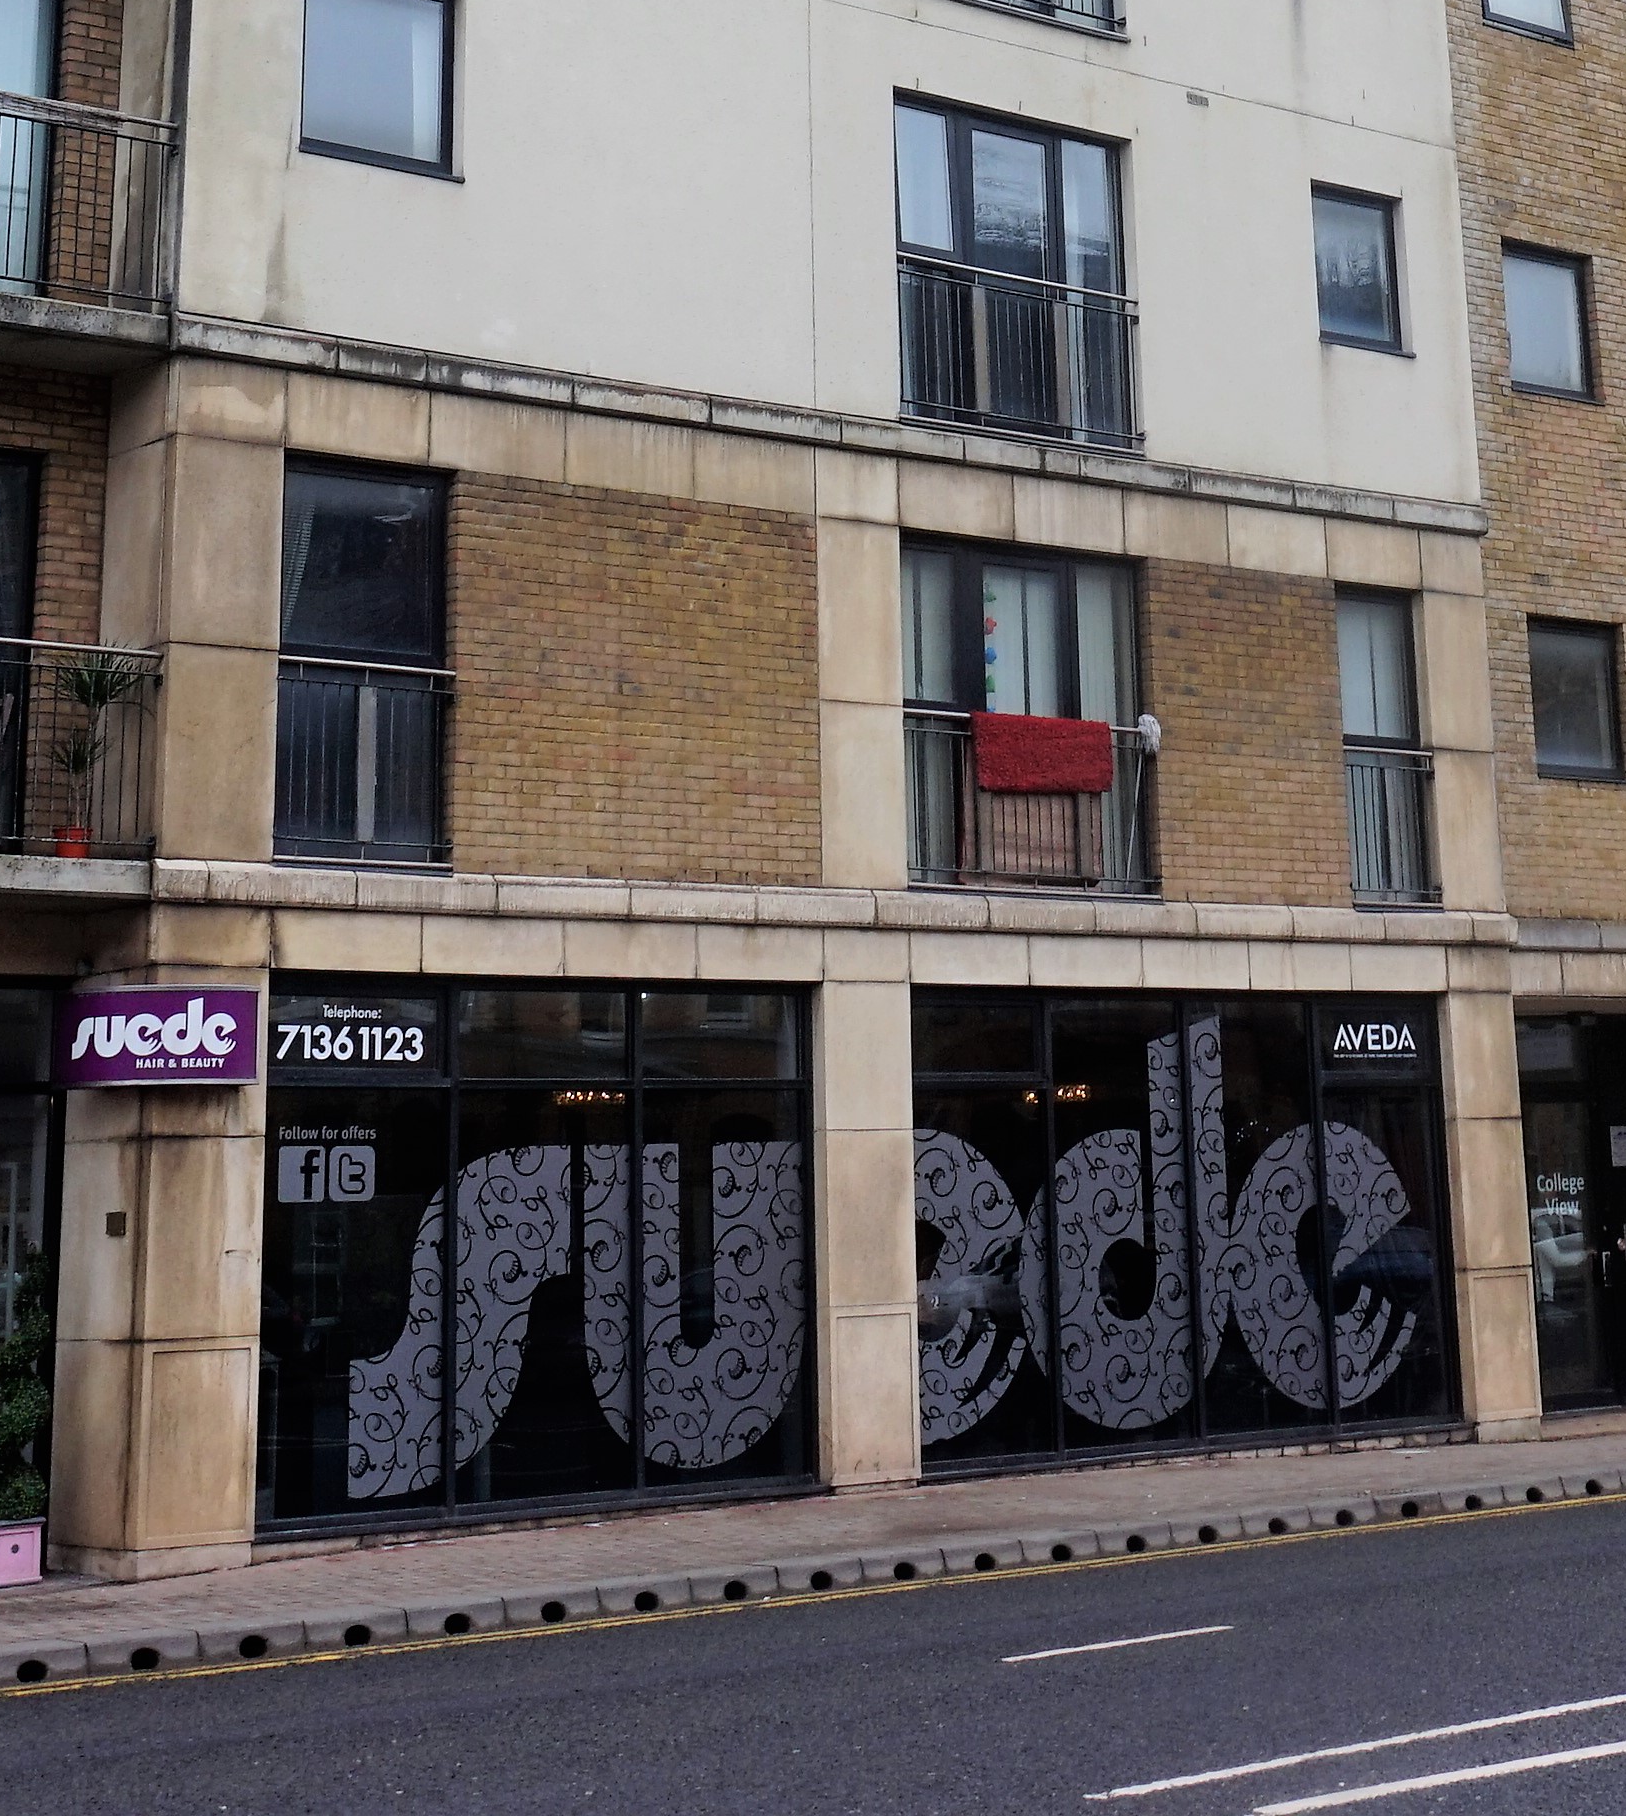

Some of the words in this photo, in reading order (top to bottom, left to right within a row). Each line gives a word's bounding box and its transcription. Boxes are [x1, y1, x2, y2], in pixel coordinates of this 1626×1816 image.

[322, 1004, 383, 1021] Telephone:
[71, 996, 238, 1060] suede
[1333, 1023, 1416, 1051] AVEDA
[135, 1058, 165, 1069] HAIR
[167, 1058, 177, 1068] &
[181, 1057, 225, 1068] BEAUTY
[278, 1125, 319, 1140] Follow
[321, 1125, 338, 1140] for
[341, 1125, 377, 1140] offers
[1536, 1172, 1585, 1195] College
[1545, 1198, 1579, 1215] View
